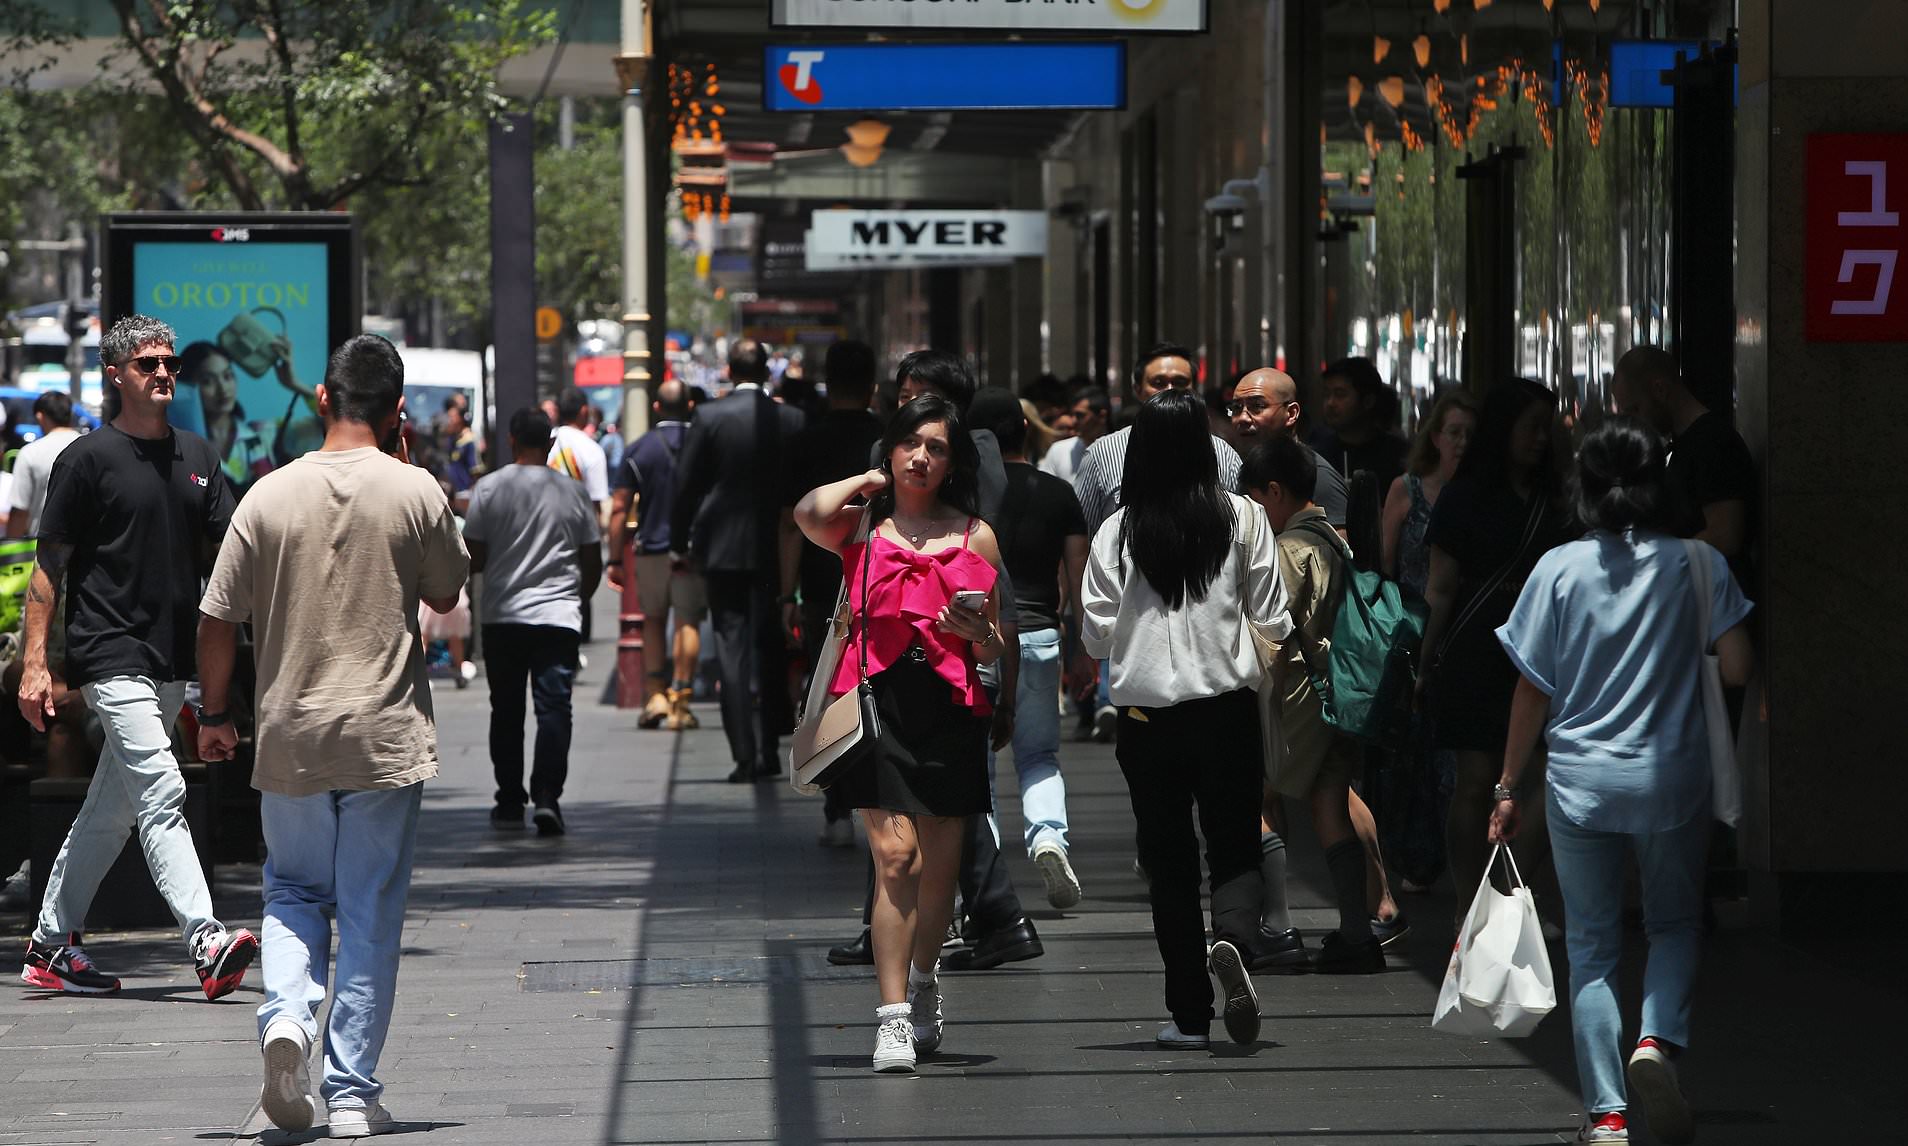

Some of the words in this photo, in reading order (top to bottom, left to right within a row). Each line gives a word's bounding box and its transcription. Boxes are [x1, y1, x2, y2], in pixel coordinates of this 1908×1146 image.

[787, 51, 825, 90] T
[852, 221, 1007, 245] MYER
[151, 281, 310, 309] OROTON
